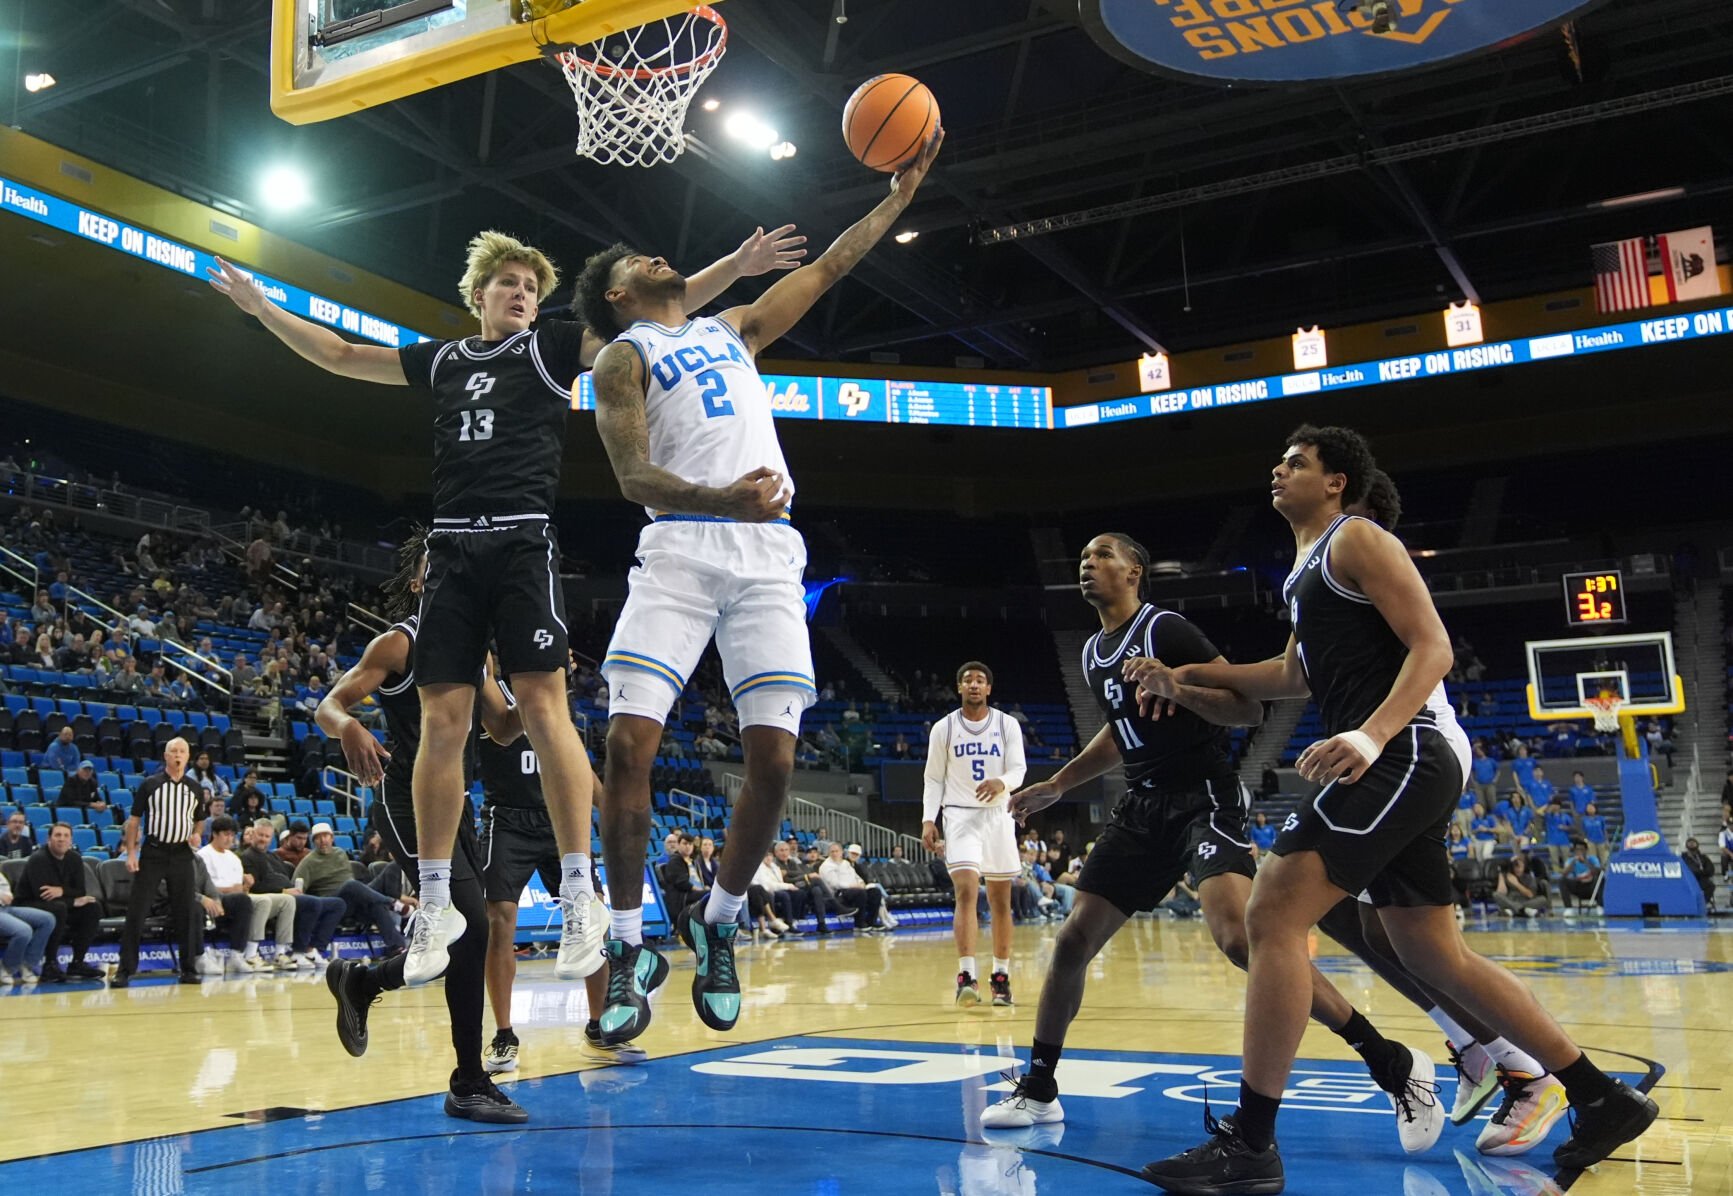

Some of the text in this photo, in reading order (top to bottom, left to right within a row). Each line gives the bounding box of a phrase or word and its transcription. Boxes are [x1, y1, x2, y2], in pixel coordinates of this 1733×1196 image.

[4, 187, 48, 216] Health
[78, 210, 196, 273] KEEP ON RISING
[309, 295, 399, 346] KEEP ON RISING
[1455, 320, 1472, 332] 31
[1640, 317, 1689, 343] KEEP
[1694, 311, 1722, 334] ON
[1301, 344, 1319, 356] 25
[1575, 331, 1623, 349] Health
[651, 343, 751, 391] UCLA
[1147, 368, 1163, 380] 42
[1378, 344, 1514, 381] KEEP ON RISING
[464, 371, 496, 401] CP
[695, 369, 735, 418] 2
[1150, 380, 1268, 415] KEEP ON RISING
[458, 408, 495, 441] 13
[1101, 403, 1137, 419] Health
[1585, 575, 1617, 592] 1:37
[1577, 593, 1611, 620] 3.2
[533, 629, 554, 650] CP
[1115, 718, 1144, 750] 11
[521, 750, 541, 775] 0
[954, 742, 1001, 758] UCLA
[972, 759, 985, 782] 5
[1610, 862, 1662, 874] WESCOM
